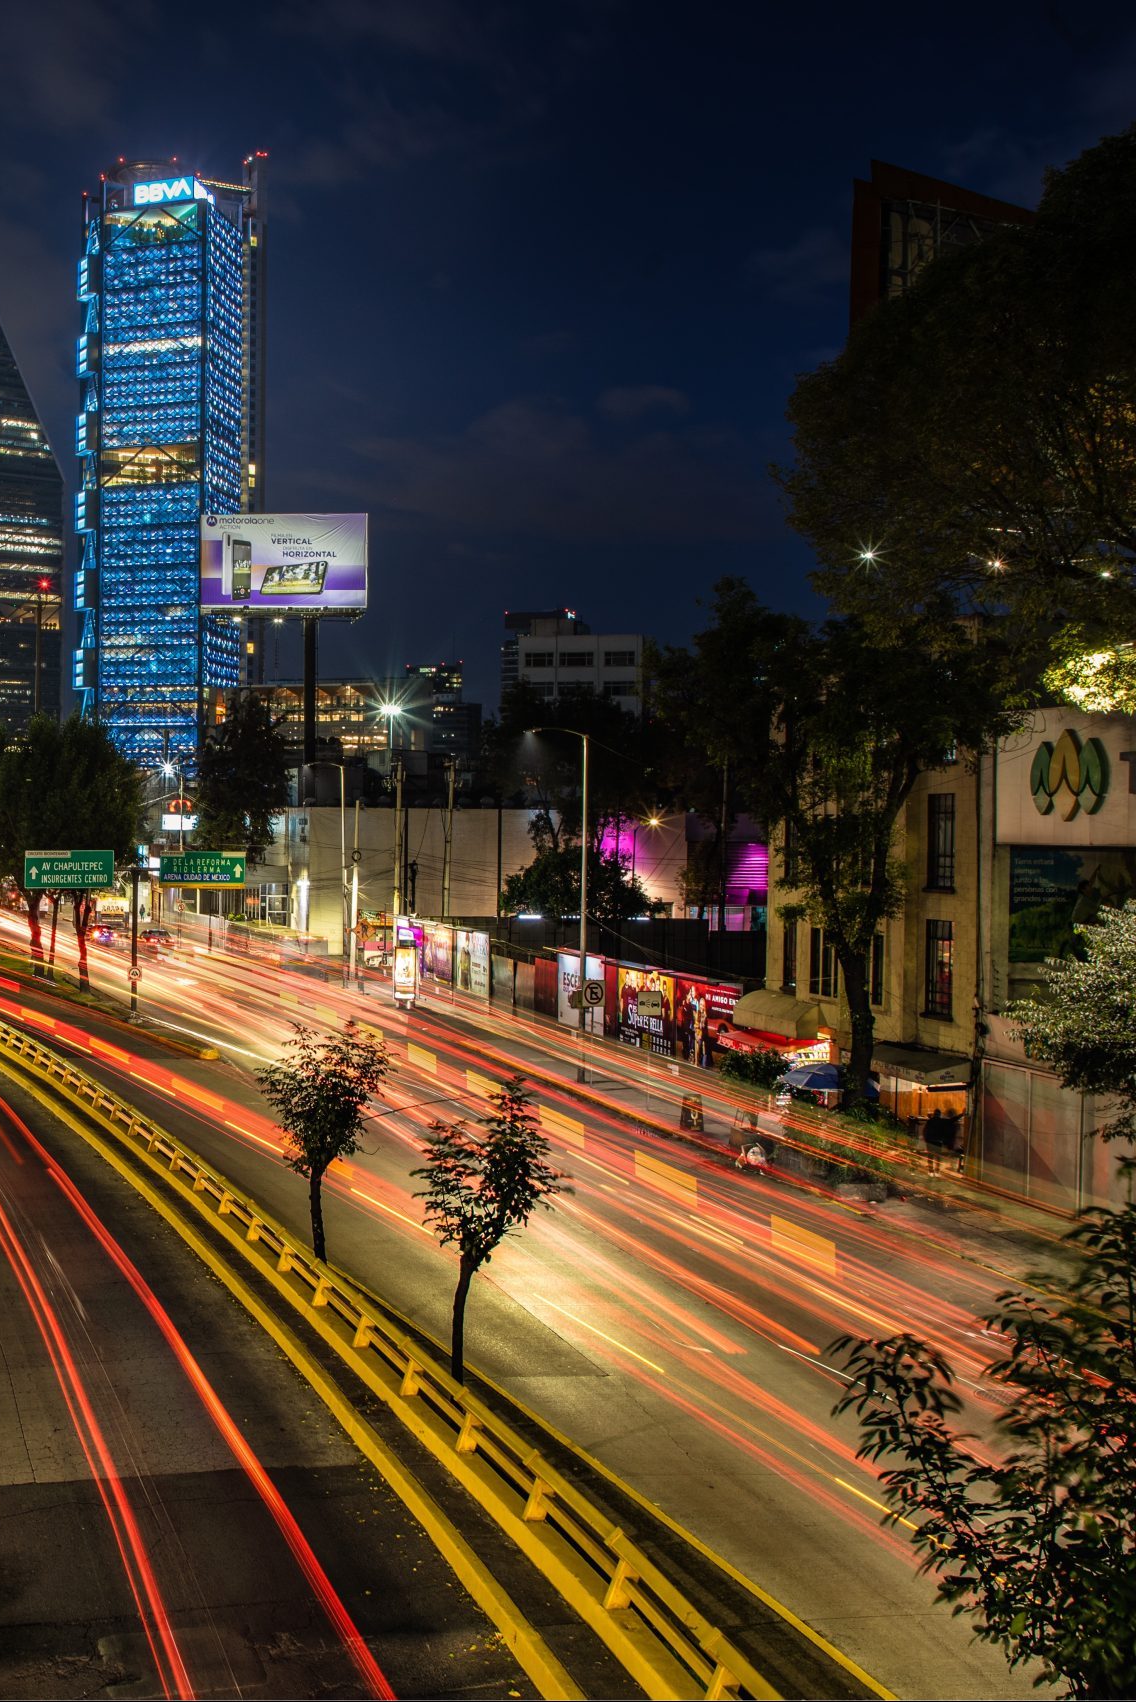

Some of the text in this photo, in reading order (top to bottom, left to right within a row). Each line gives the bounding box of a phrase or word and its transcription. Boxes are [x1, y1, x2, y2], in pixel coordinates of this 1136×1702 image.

[134, 178, 192, 204] BBVA
[41, 862, 103, 871] AV CHAPULTEPEC
[196, 858, 231, 866] REFORMA
[41, 874, 108, 884] INSURGENTES CENTRO
[712, 995, 728, 1005] AMIGO
